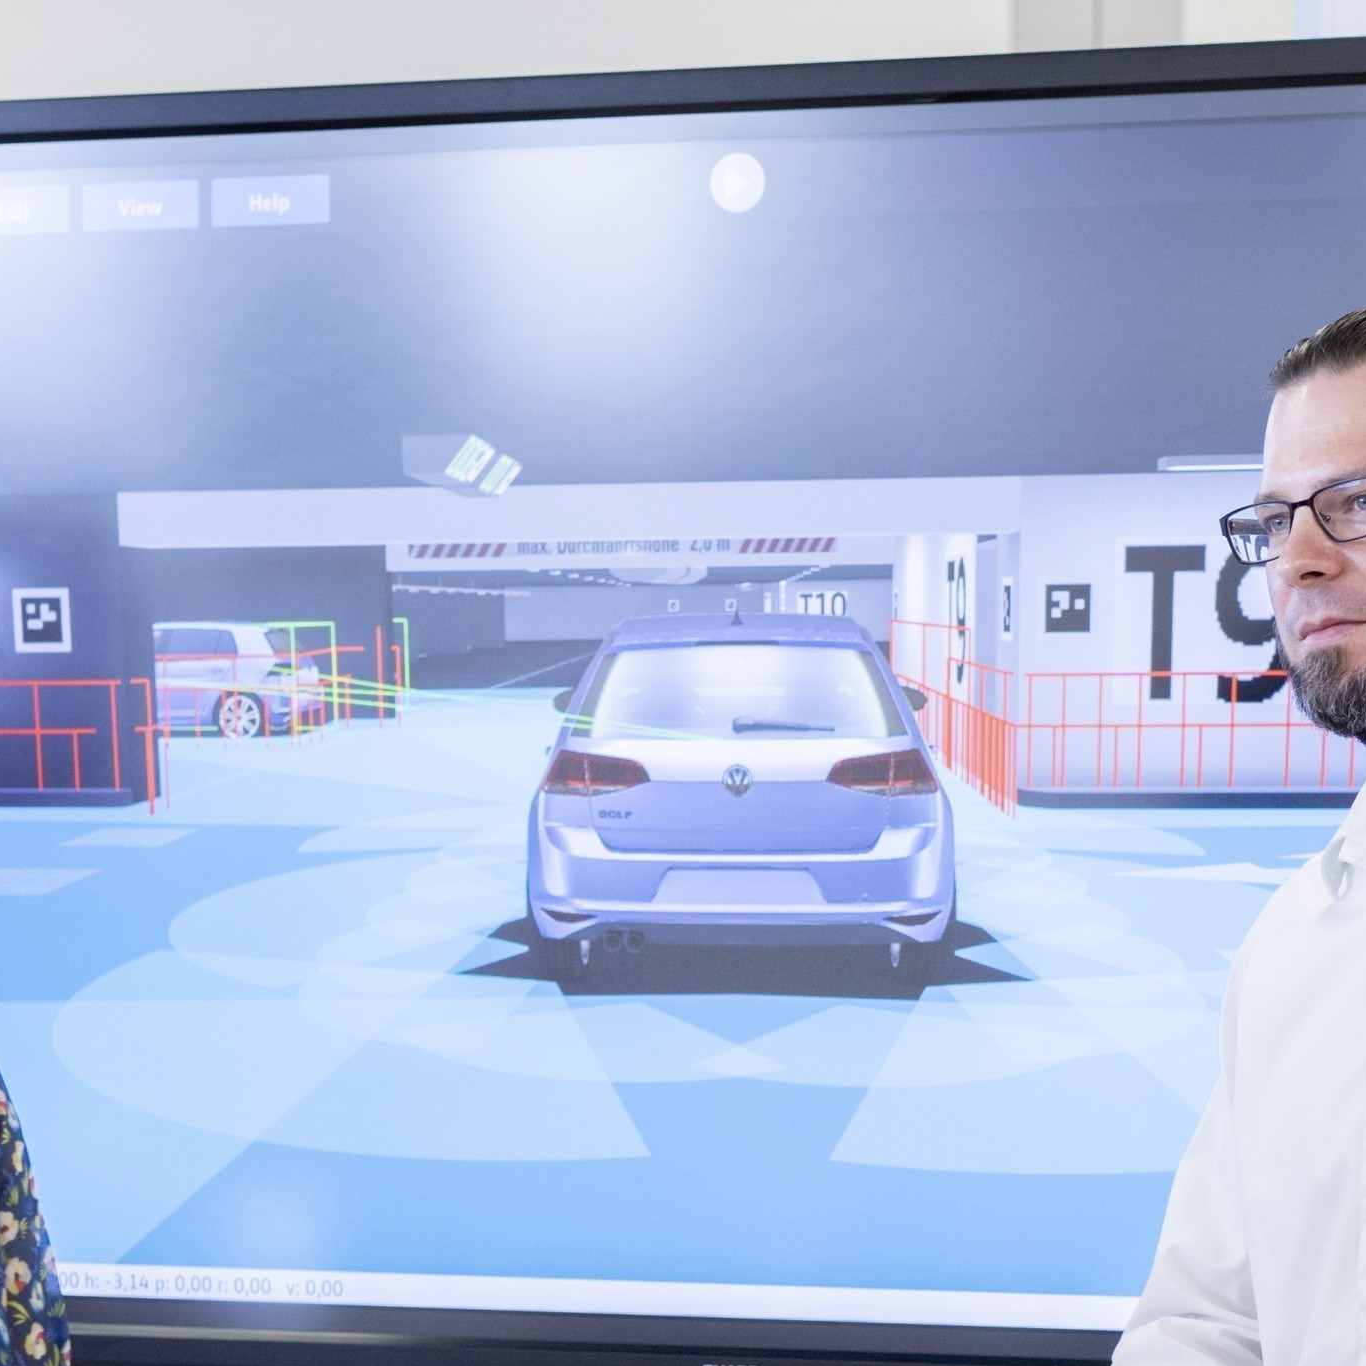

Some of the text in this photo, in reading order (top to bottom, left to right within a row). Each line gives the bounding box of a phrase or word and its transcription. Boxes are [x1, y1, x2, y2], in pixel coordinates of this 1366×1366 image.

[117, 199, 162, 217] View
[248, 194, 291, 216] Help
[800, 592, 846, 616] T10
[105, 1273, 149, 1292] -3,14
[155, 1278, 169, 1294] p:
[175, 1275, 212, 1295] 0,00
[234, 1276, 272, 1297] 0,00
[305, 1279, 344, 1299] 0,00
